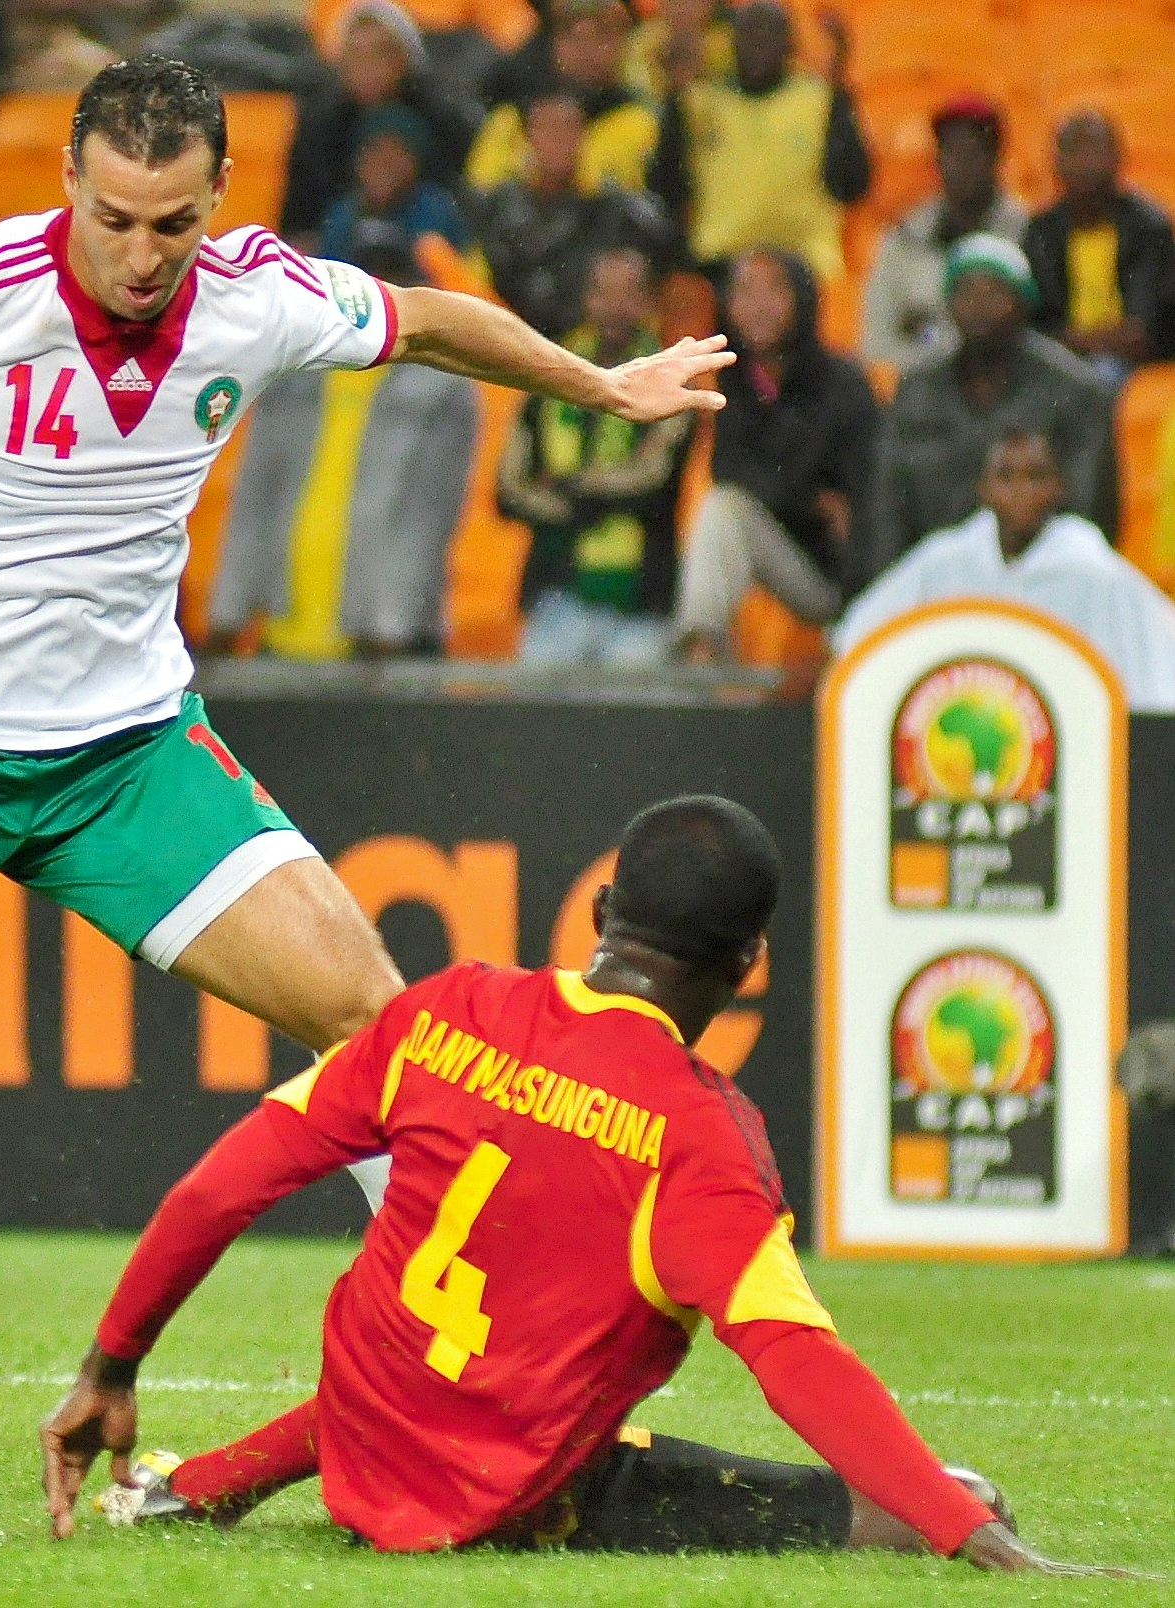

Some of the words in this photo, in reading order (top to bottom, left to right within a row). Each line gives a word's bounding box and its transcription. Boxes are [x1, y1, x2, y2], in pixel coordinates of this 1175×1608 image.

[5, 362, 79, 460] 14
[404, 1008, 487, 1086] DANY
[462, 1046, 668, 1170] MASUNGUNA
[399, 1140, 512, 1384] 4
